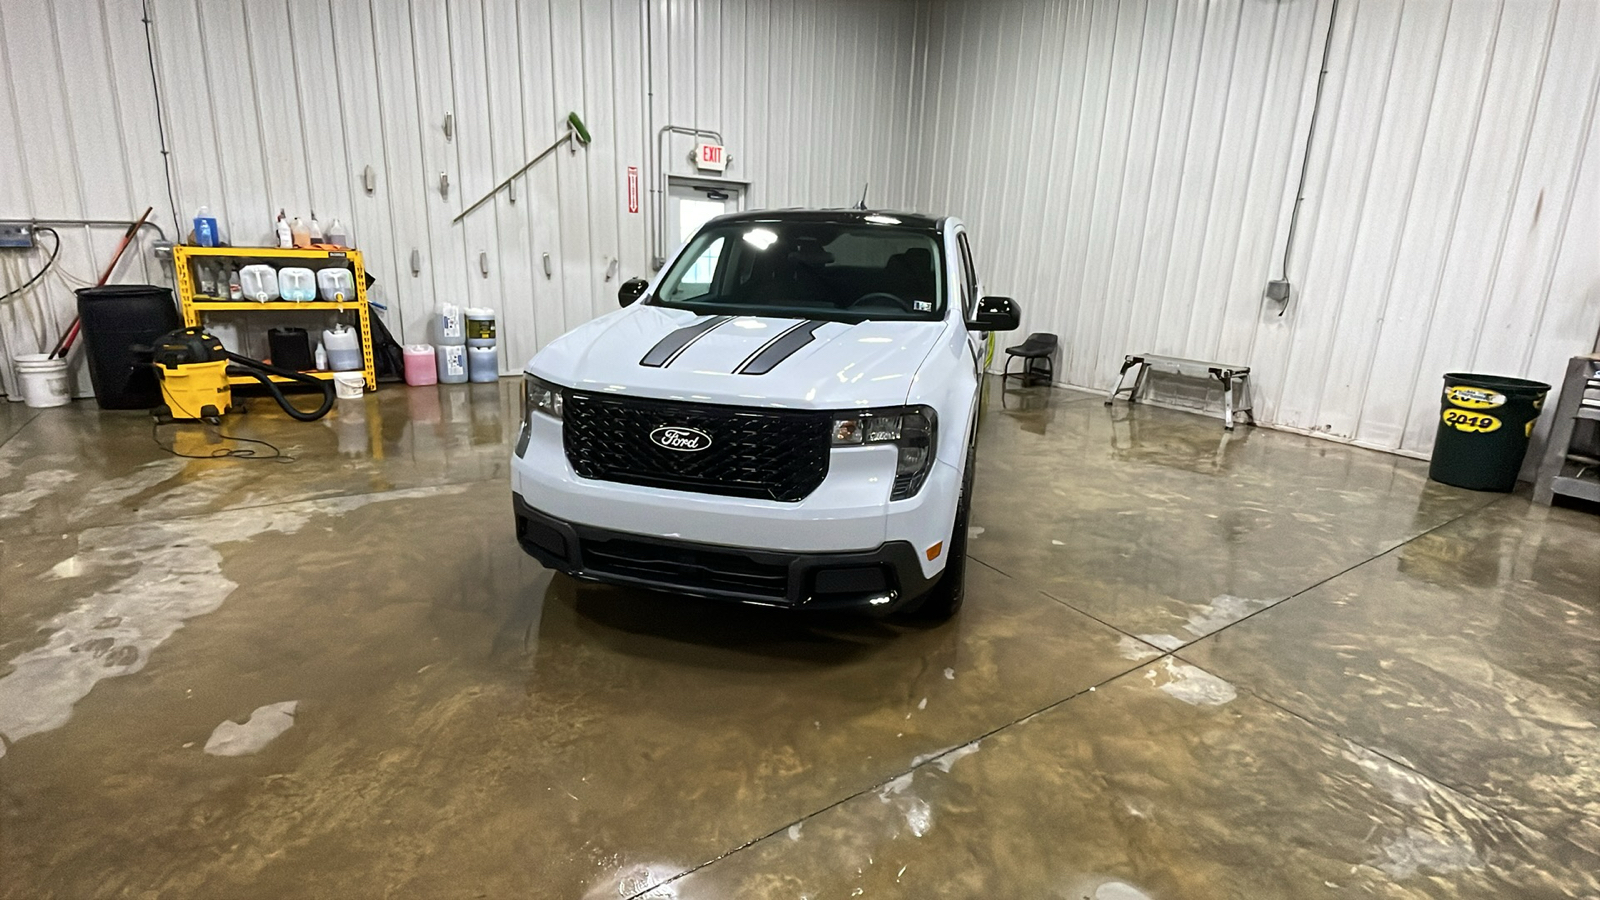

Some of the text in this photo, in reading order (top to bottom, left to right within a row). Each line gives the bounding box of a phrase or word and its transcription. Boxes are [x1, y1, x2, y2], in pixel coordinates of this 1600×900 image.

[703, 145, 722, 163] EXIT
[1446, 412, 1493, 428] 2019
[661, 429, 700, 448] Ford
